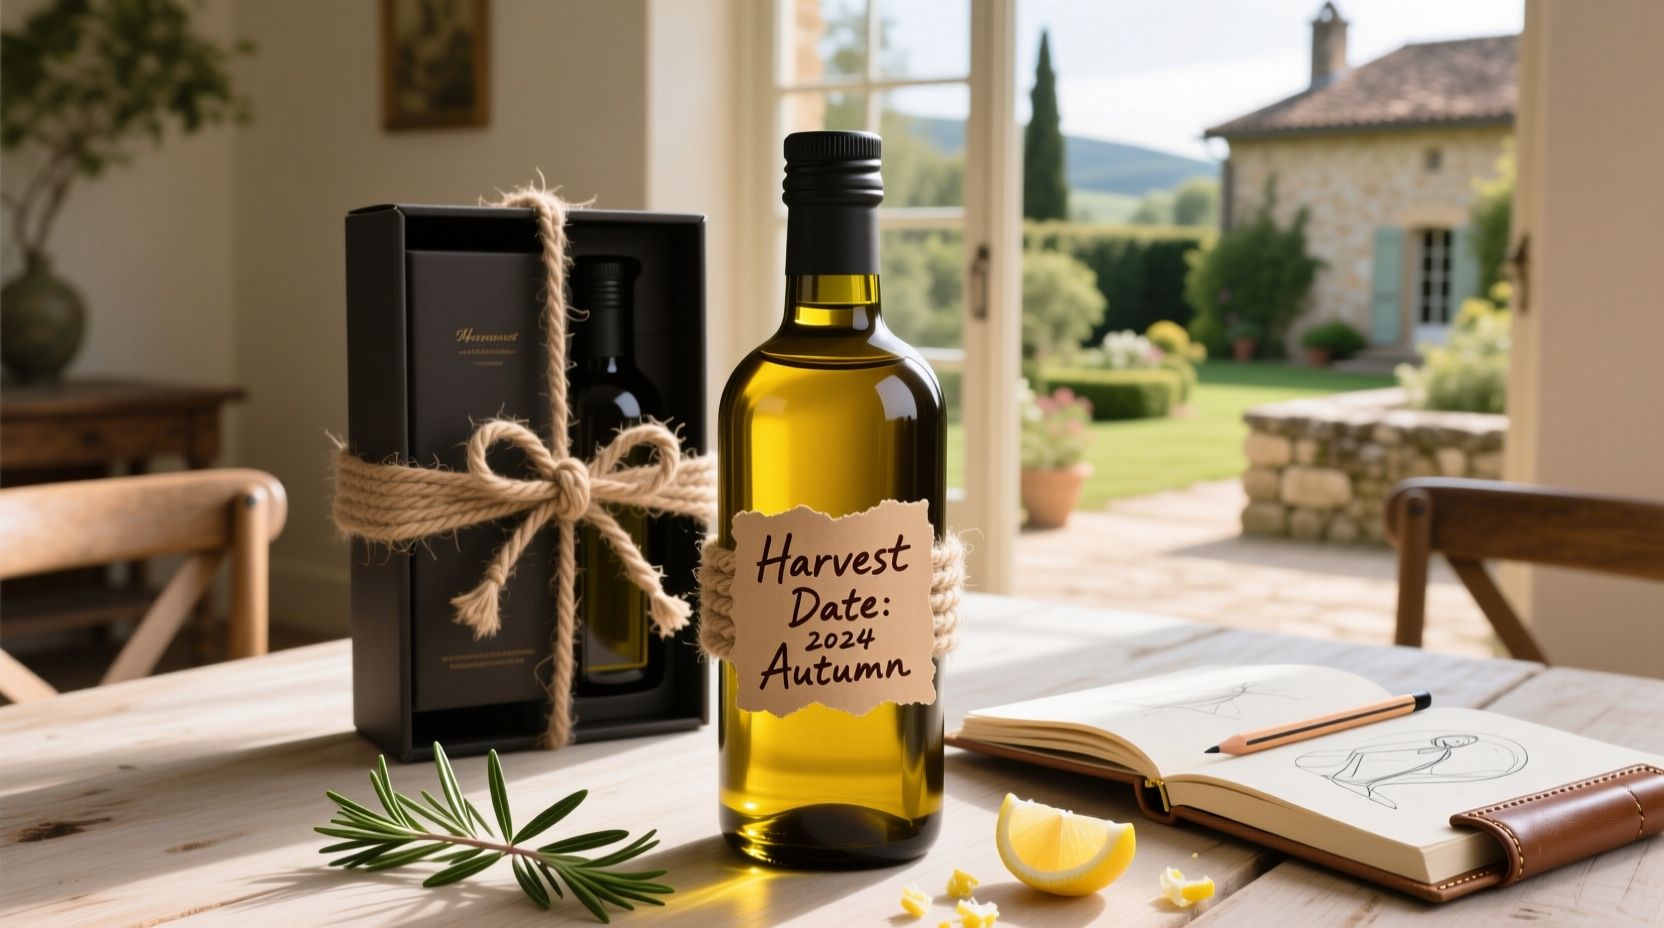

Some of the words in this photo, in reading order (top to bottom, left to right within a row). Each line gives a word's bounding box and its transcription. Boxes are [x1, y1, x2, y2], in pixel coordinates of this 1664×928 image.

[756, 532, 911, 584] Harvest
[788, 587, 890, 628] Date:
[804, 628, 875, 652] 2024
[759, 642, 911, 690] Autumn
